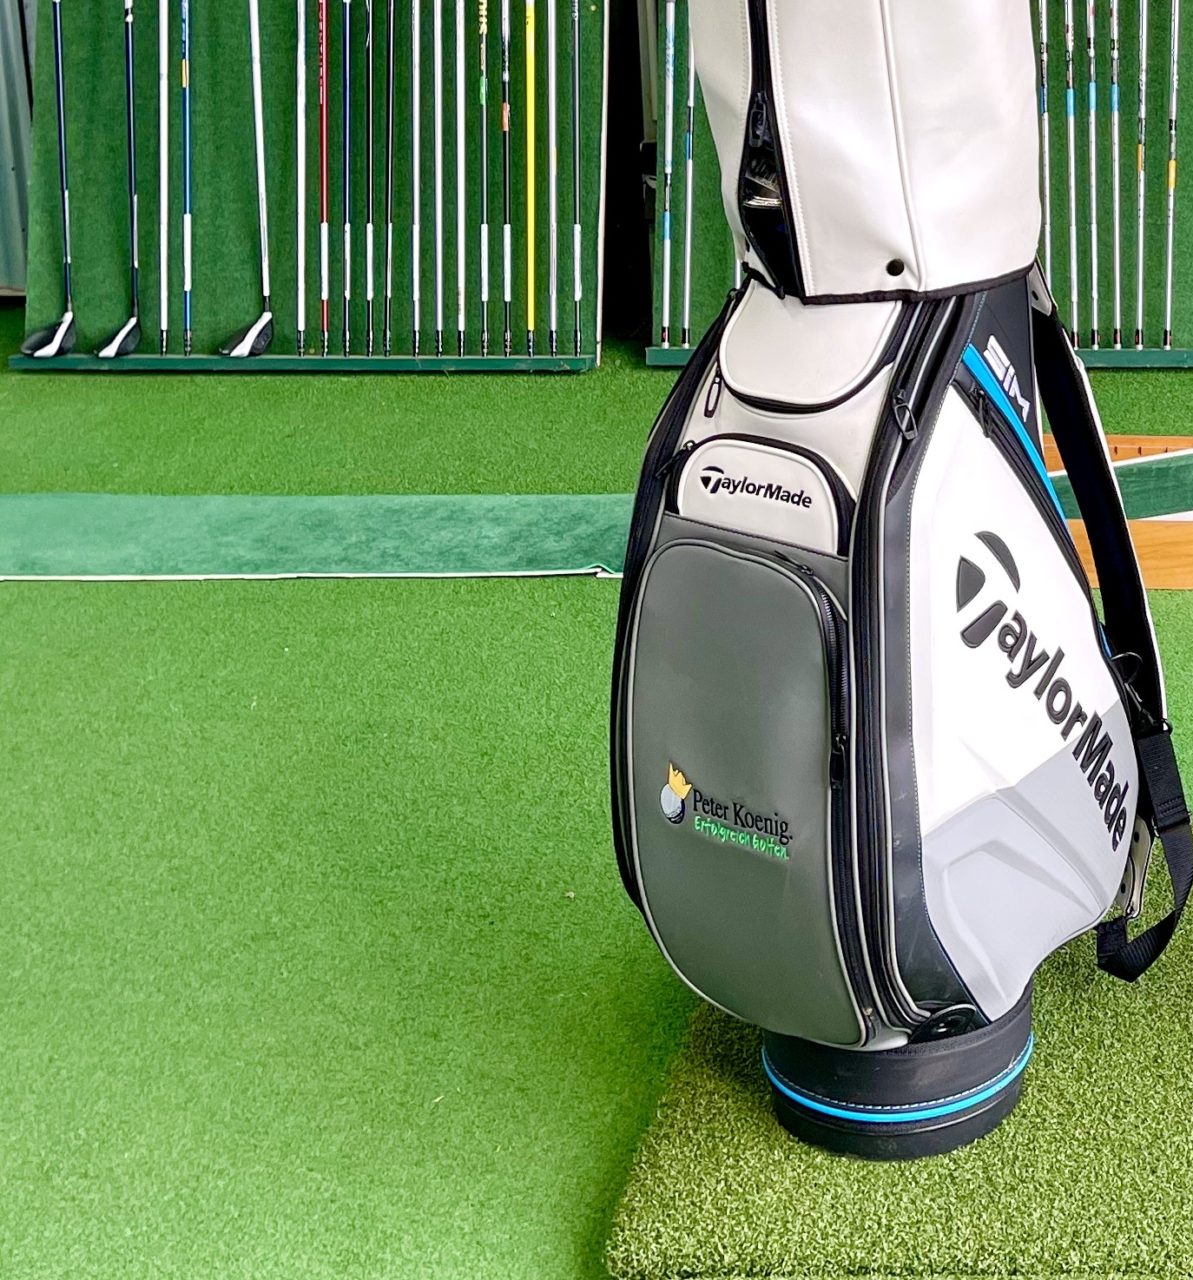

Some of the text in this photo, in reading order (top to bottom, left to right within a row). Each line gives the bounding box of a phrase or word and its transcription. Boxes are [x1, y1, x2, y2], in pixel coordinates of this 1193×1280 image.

[700, 465, 812, 508] TaylorMade
[955, 530, 1129, 852] TaylorMade
[692, 788, 793, 846] Peter Koenig.
